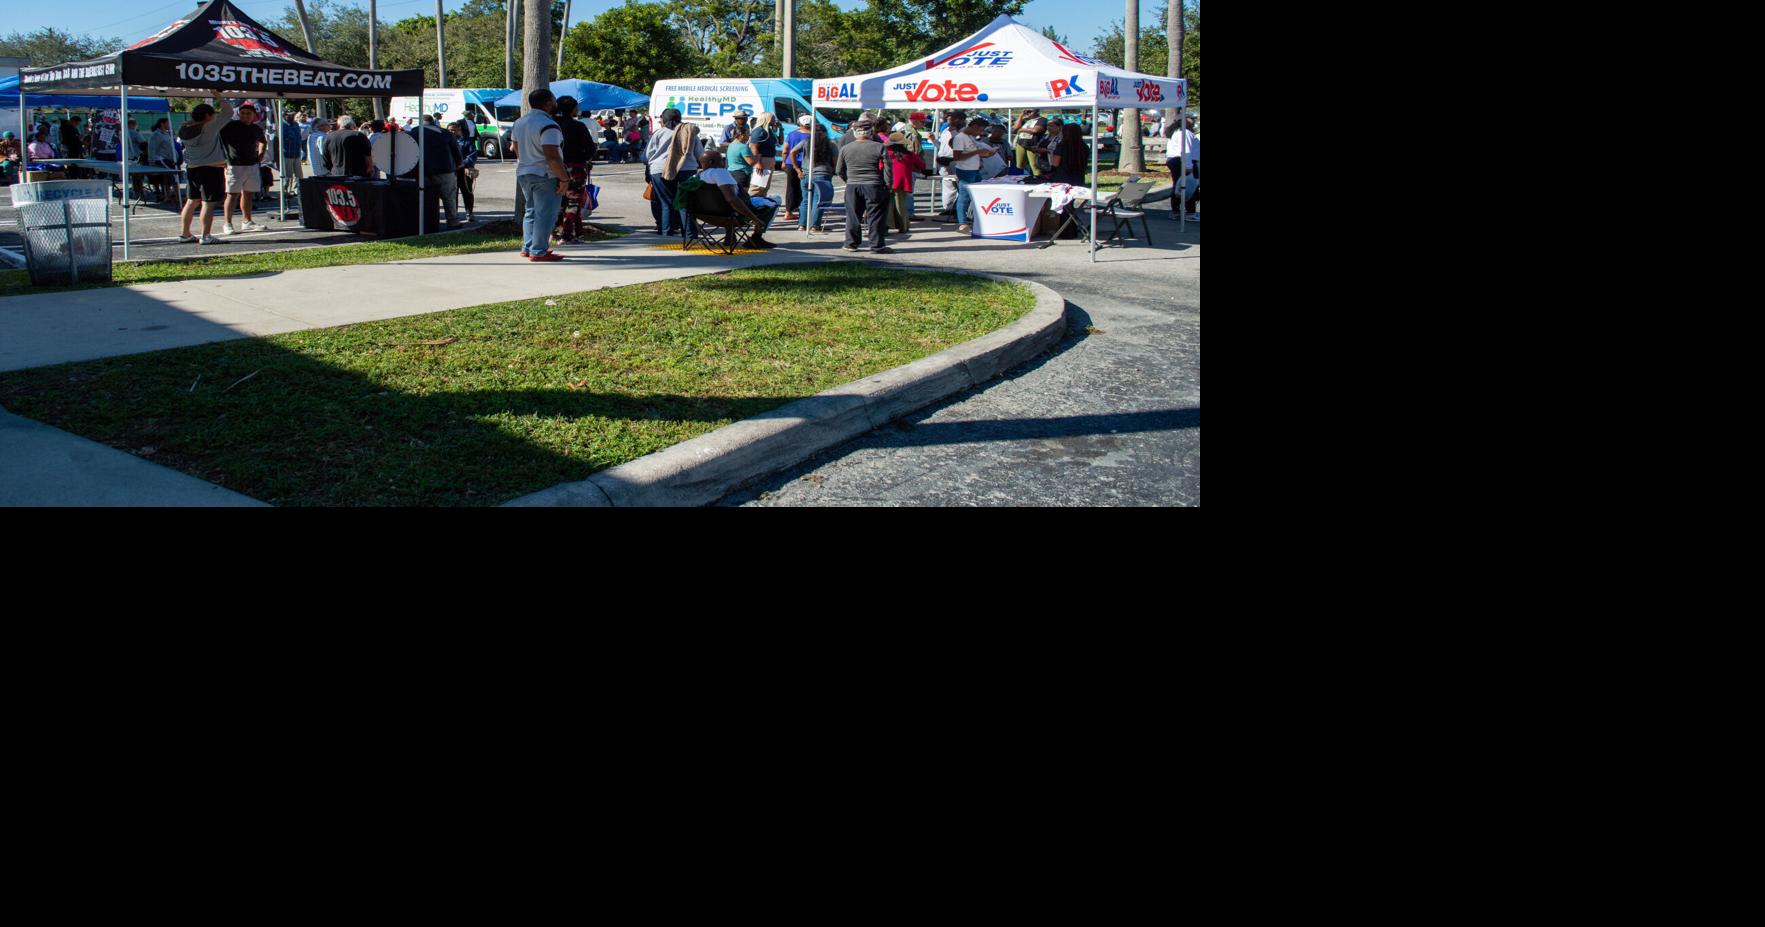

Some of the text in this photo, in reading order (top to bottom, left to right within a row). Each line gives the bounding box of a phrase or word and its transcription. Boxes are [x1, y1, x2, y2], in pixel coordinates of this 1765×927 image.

[175, 62, 392, 89] 1035THEBEAT.COM
[893, 82, 918, 90] JUST
[1050, 75, 1085, 98] PK
[325, 188, 357, 208] 103.5
